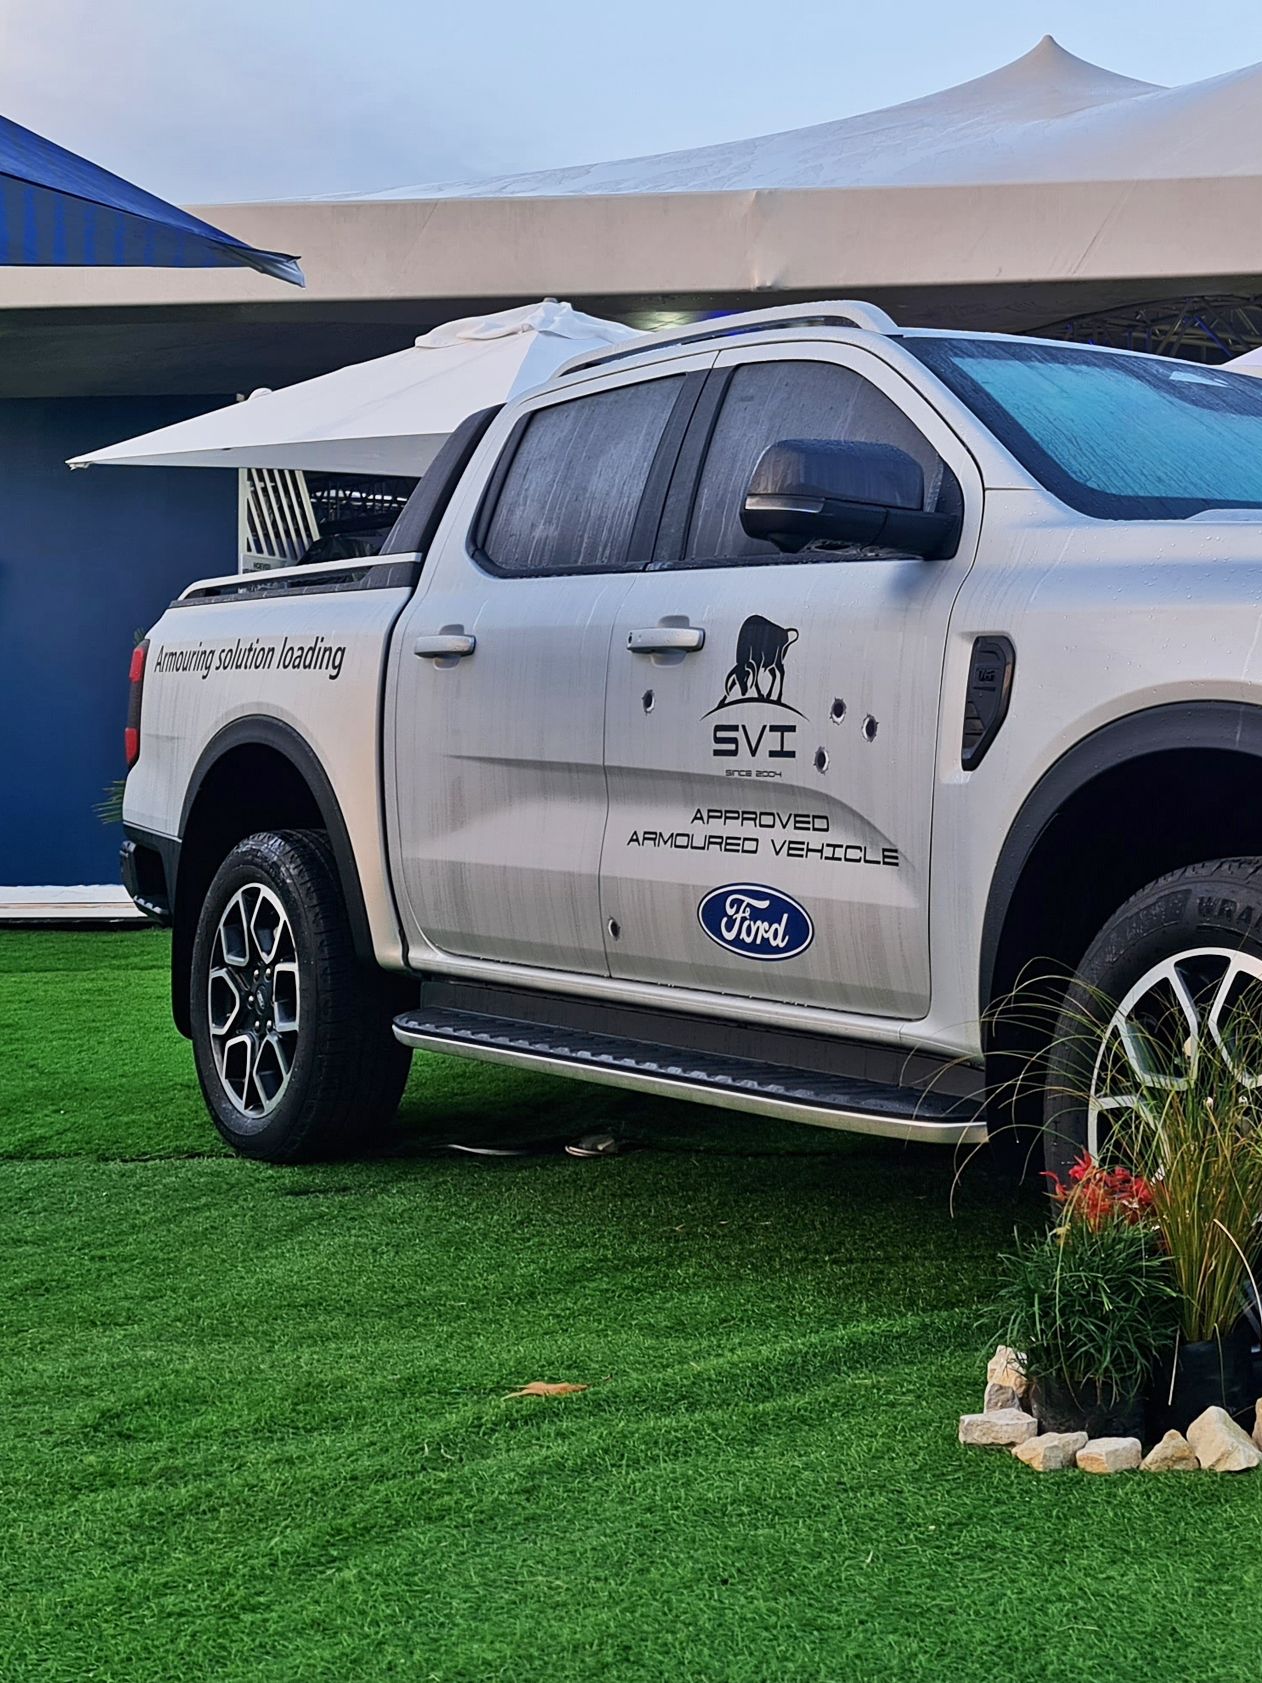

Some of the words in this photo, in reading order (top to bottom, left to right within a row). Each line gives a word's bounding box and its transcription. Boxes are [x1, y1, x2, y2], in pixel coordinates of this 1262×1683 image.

[154, 641, 216, 680] Armouring
[215, 637, 275, 671] solution
[276, 636, 346, 680] loading
[713, 724, 797, 758] SVI
[755, 770, 782, 778] 2004
[690, 808, 830, 833] APPROVED
[627, 830, 759, 854] ARMOURED
[771, 839, 899, 867] VEHICLE
[720, 894, 789, 948] Ford
